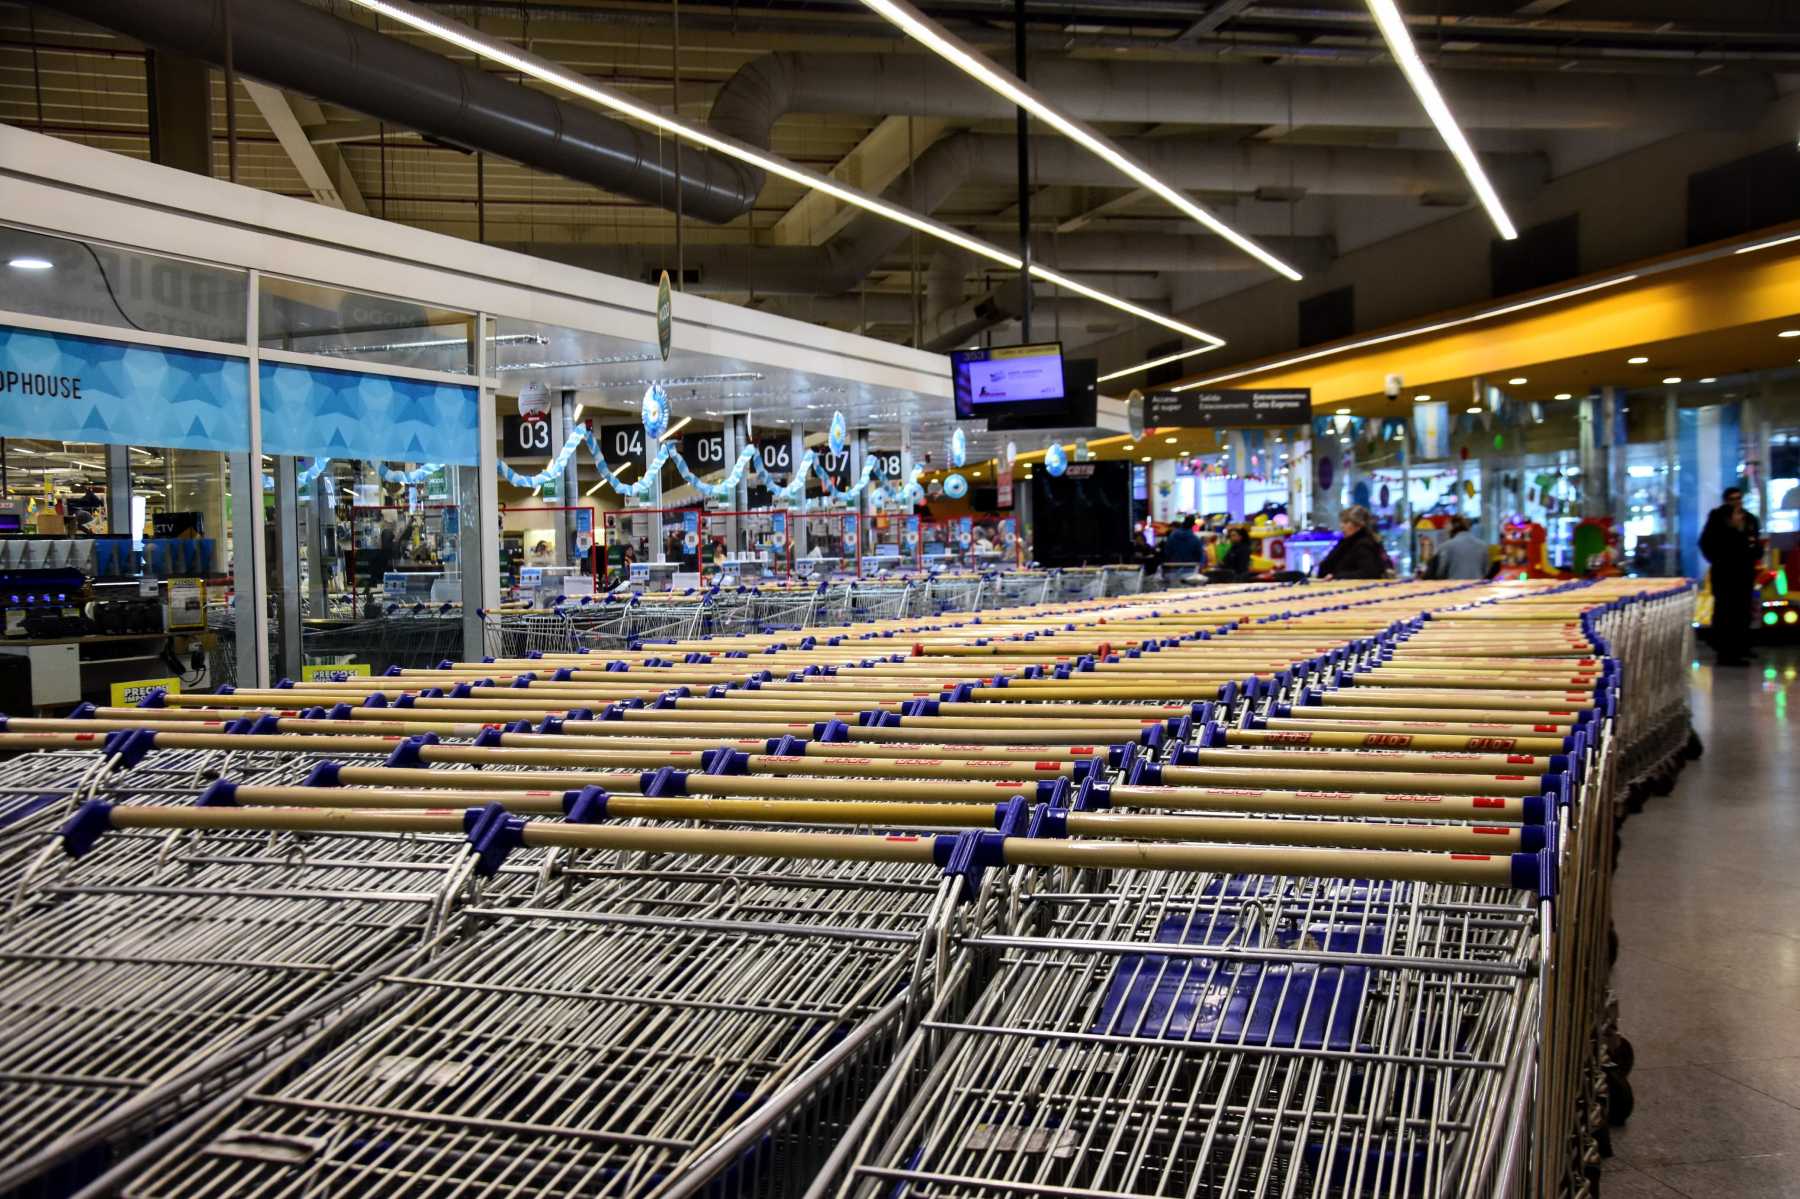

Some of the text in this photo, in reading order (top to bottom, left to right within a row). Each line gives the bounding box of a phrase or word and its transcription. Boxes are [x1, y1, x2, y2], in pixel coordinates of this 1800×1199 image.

[519, 420, 549, 450] 03
[615, 430, 643, 457] 04
[697, 437, 723, 462] 05
[763, 444, 790, 468] 06
[825, 450, 849, 472] 07
[1366, 734, 1411, 747] COTO
[1469, 738, 1515, 750] COTO
